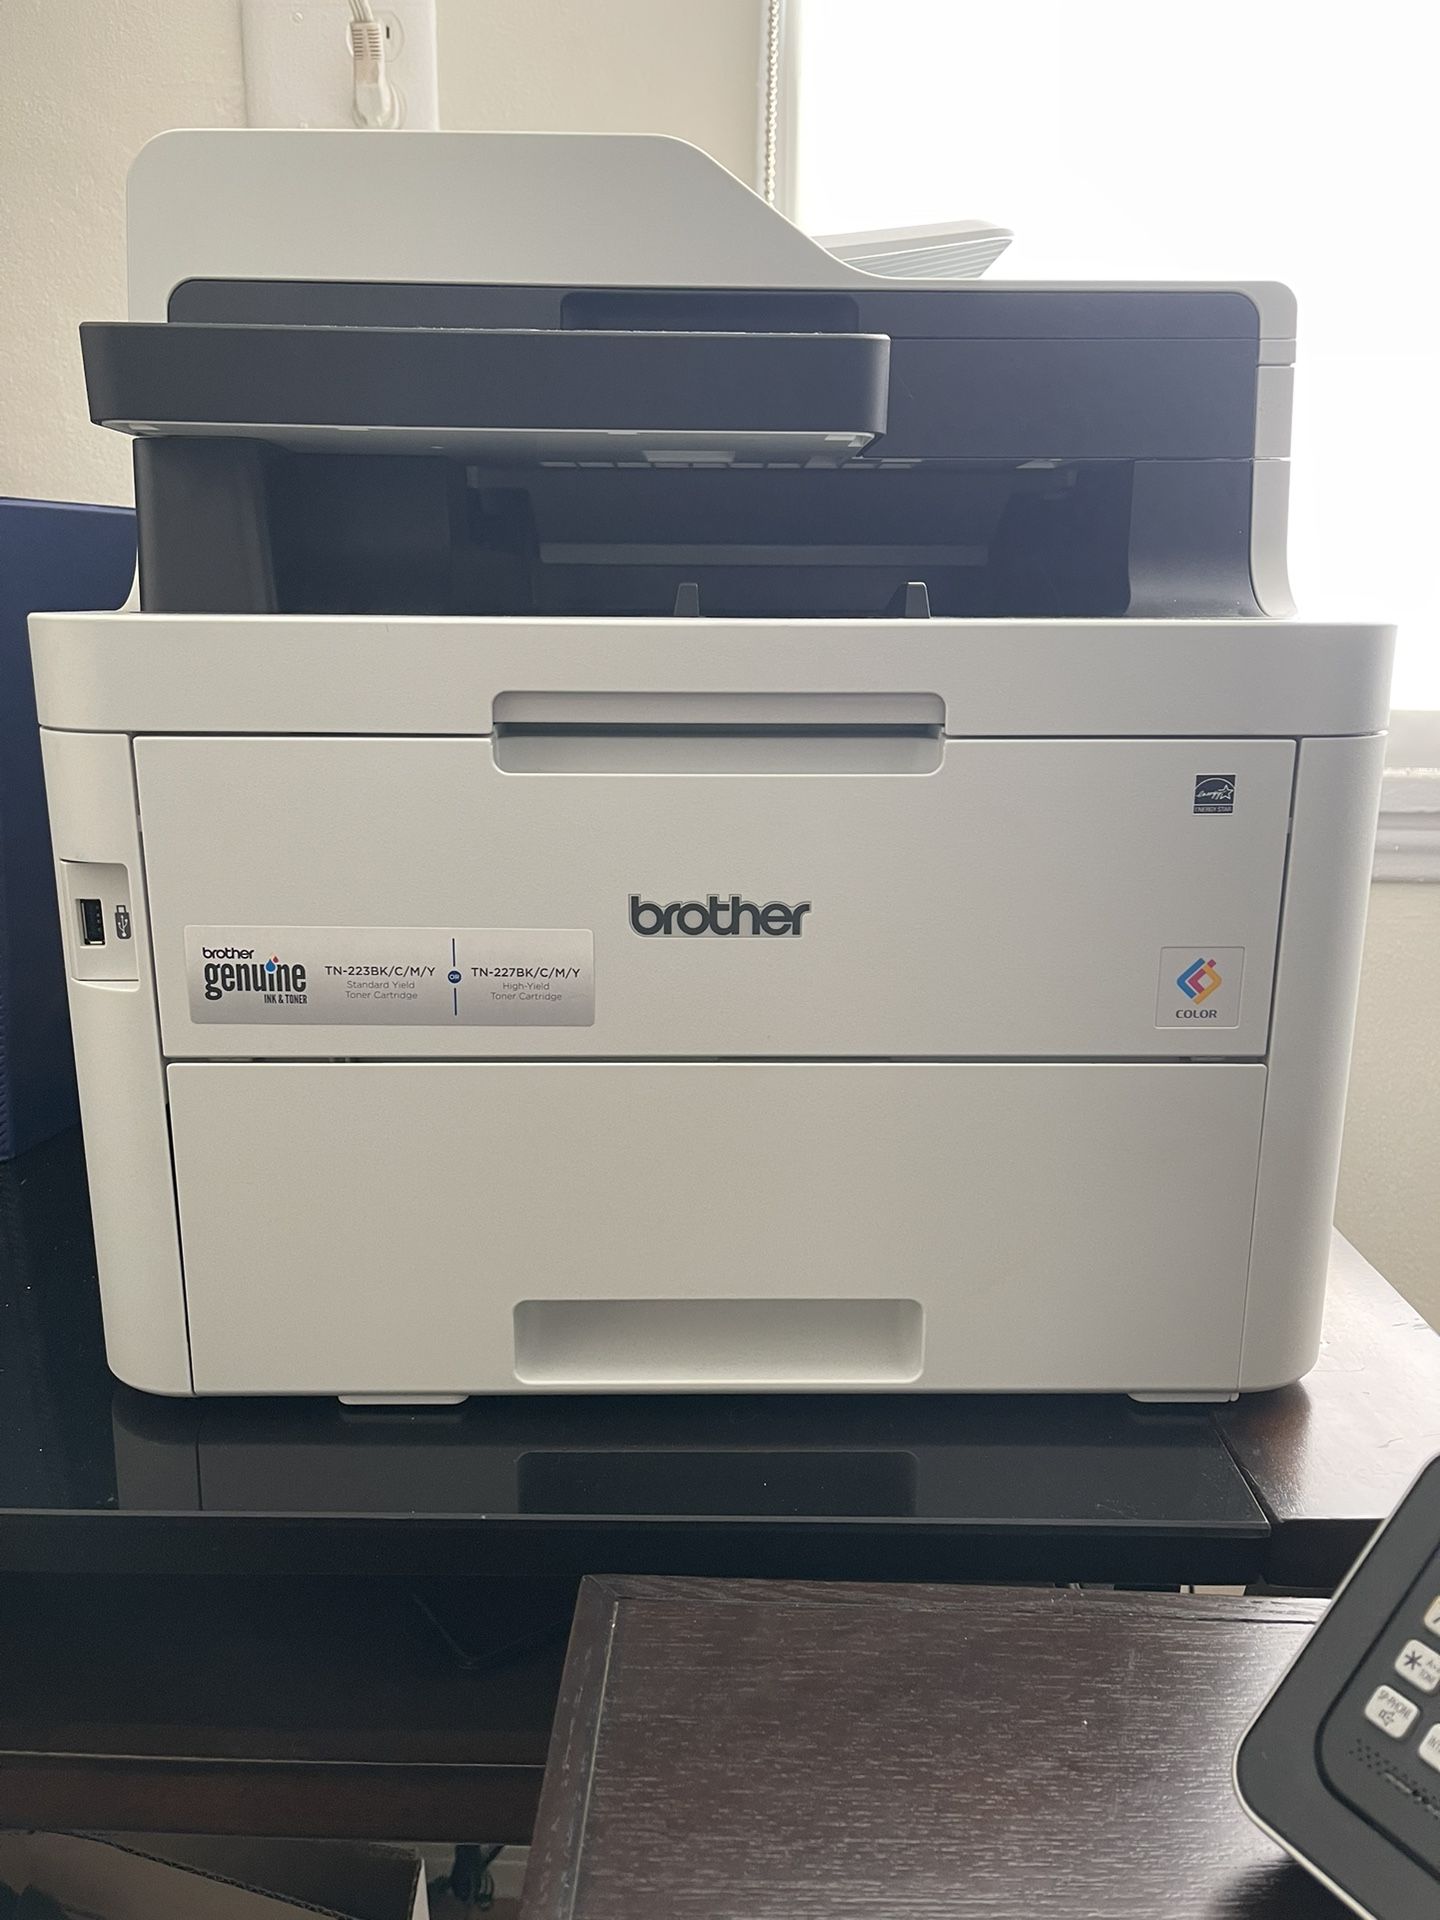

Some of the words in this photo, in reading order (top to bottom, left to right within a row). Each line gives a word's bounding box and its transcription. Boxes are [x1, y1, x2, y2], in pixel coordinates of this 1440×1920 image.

[630, 895, 810, 936] brother
[202, 947, 254, 959] brother
[324, 965, 436, 977] TN-223BK/C/M/Y
[471, 967, 580, 979] TN-227BK/C/M/Y
[204, 962, 306, 1000] genuine
[346, 980, 390, 989] Standard
[392, 981, 415, 989] Yield
[502, 982, 550, 991] High-Yield
[264, 994, 277, 1004] INK
[278, 994, 284, 1004] &
[285, 994, 308, 1004] TONER
[345, 991, 371, 999] Toner
[373, 991, 418, 1000] Cartridge
[490, 992, 516, 1000] Toner
[518, 992, 562, 1001] Cartridge
[1175, 1009, 1218, 1019] COLOR
